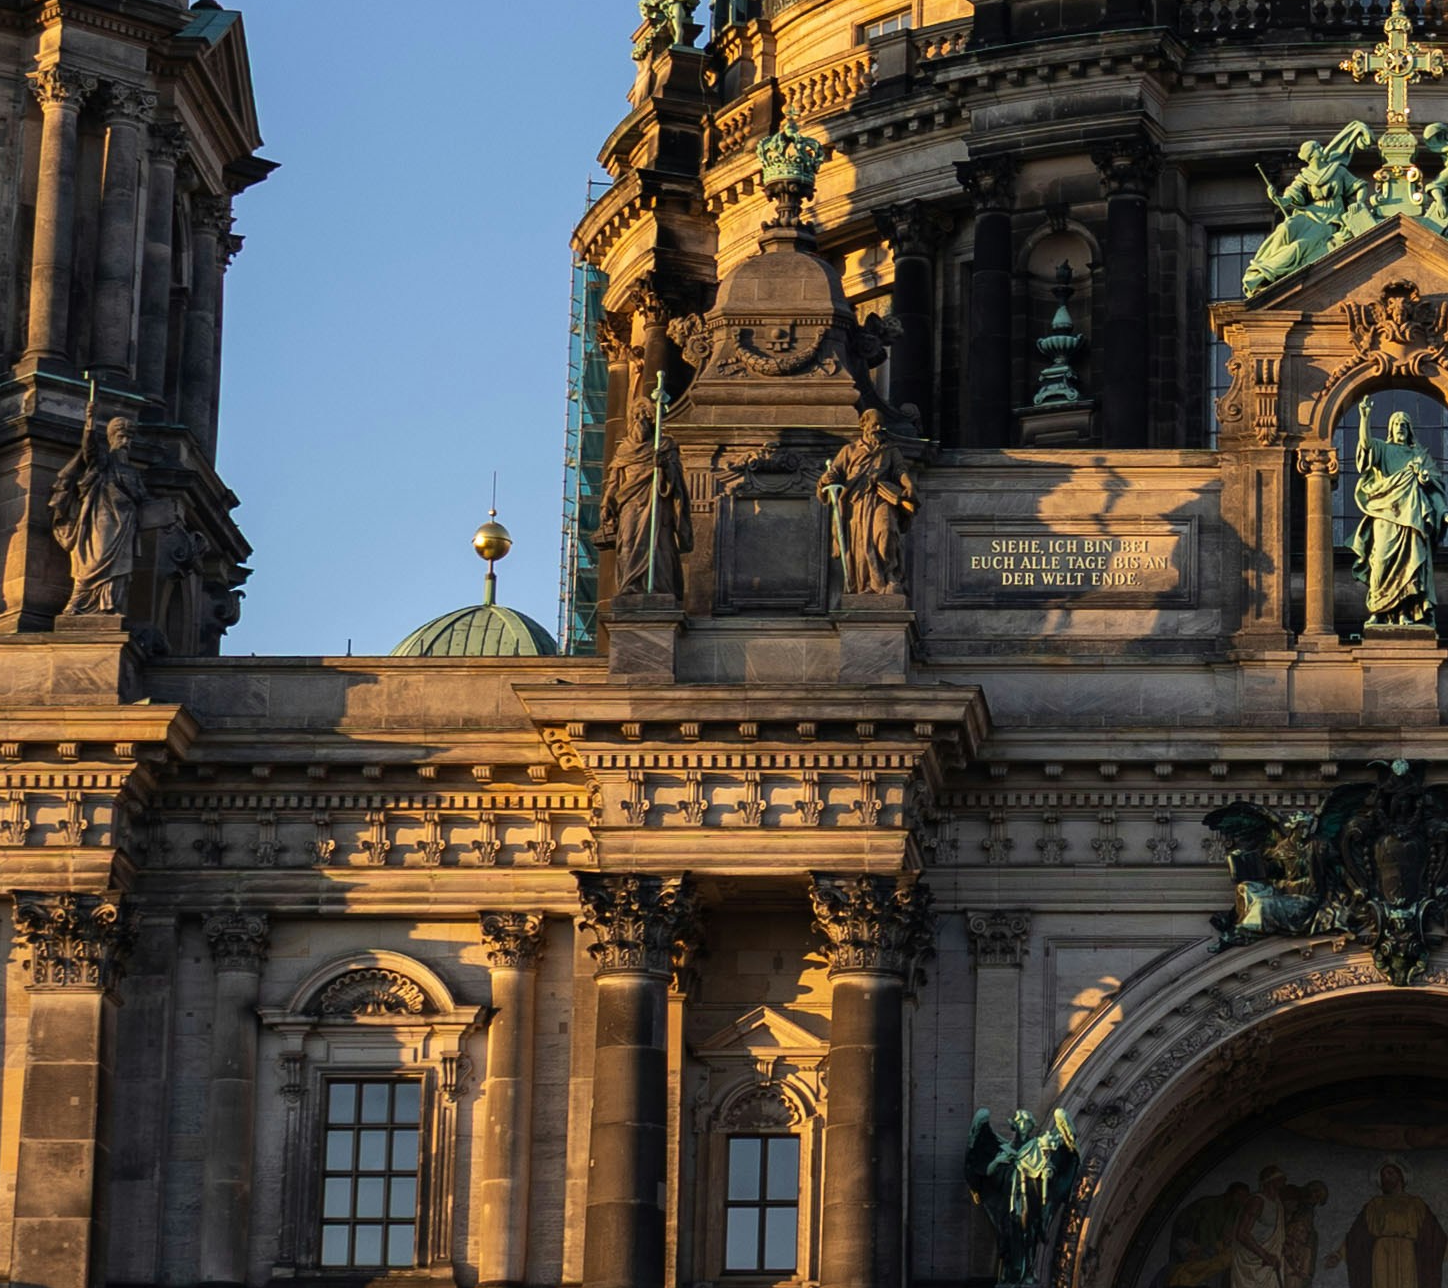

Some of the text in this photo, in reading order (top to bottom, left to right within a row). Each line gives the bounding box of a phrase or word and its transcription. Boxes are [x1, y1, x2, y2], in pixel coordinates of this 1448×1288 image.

[991, 539, 1149, 554] SIEHE, ICH BIN BEI
[971, 556, 1169, 570] EUCH ALLE TAGE BIS AN
[1002, 572, 1142, 586] DER WELT ENDE.
